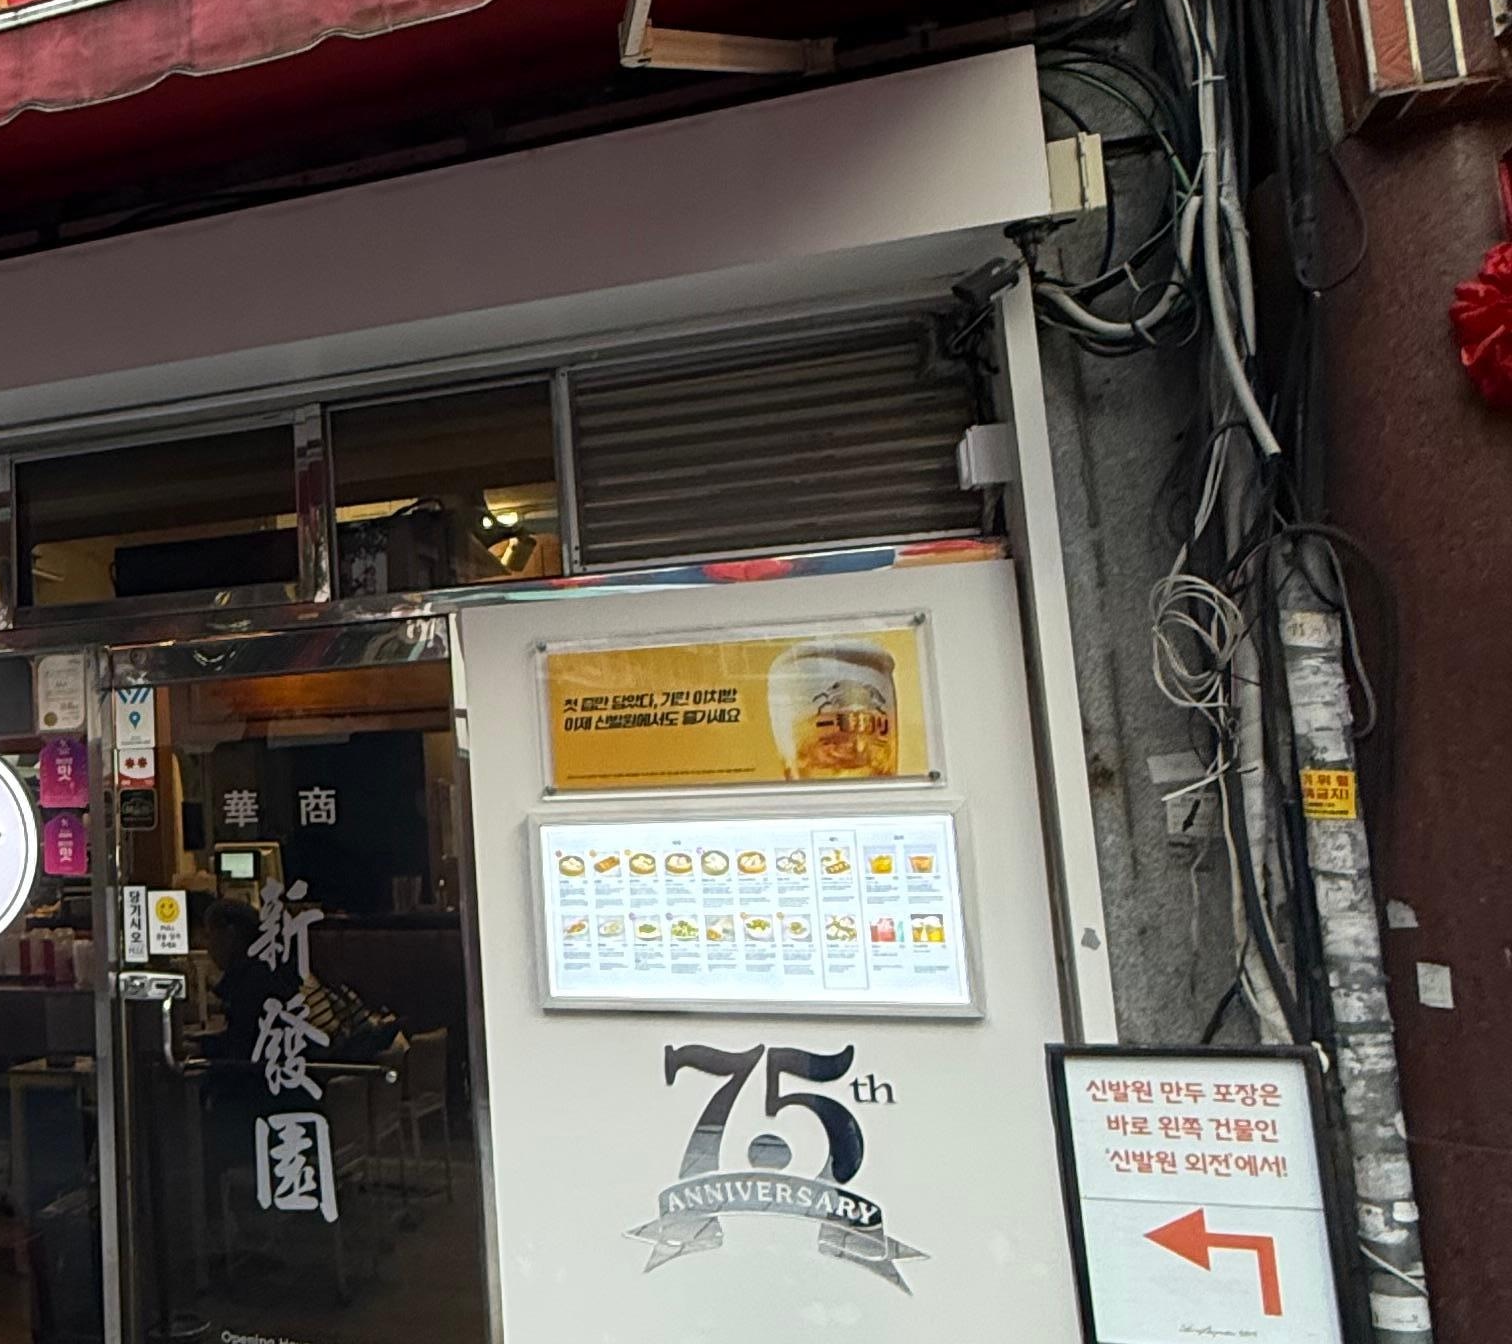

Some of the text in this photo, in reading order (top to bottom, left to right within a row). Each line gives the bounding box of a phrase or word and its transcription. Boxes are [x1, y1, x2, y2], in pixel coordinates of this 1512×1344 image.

[129, 890, 144, 944] 당기시오
[245, 878, 338, 1223] 新發園
[1086, 1079, 1283, 1108] 신발원 만두 포장은
[1106, 1115, 1280, 1143] 바로 왼쪽 건물인
[668, 1180, 880, 1225] ANNIVERSARY
